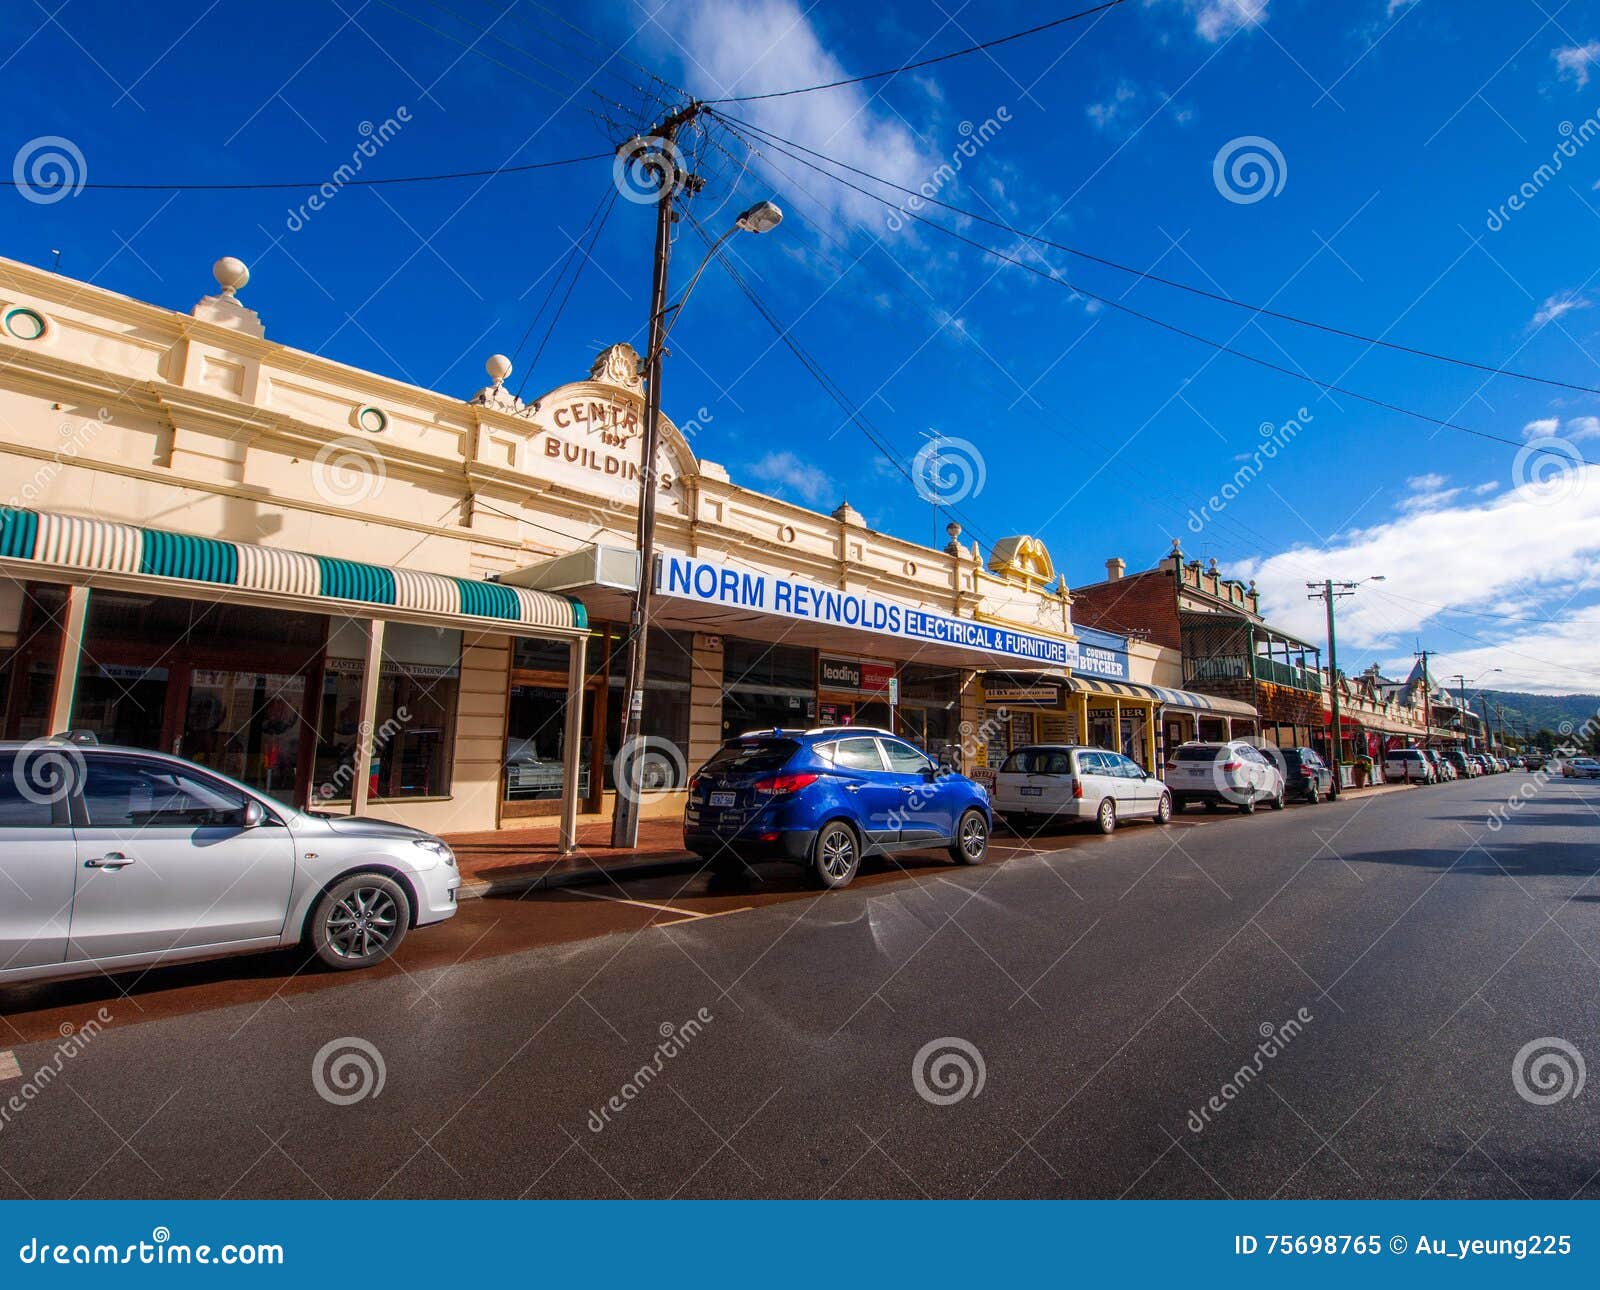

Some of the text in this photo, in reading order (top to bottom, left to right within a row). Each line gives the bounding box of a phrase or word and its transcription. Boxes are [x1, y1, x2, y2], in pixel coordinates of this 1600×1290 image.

[544, 437, 672, 489] BUILDINS
[668, 557, 765, 608] NORM
[774, 580, 901, 633] REYNOLDS
[907, 610, 992, 649] ELECTRICAL
[994, 632, 1004, 650] &
[1005, 634, 1065, 662] FURNITURE
[1079, 655, 1123, 676] BUTCHER
[1086, 648, 1115, 662] COUNTRY
[823, 663, 860, 685] leading
